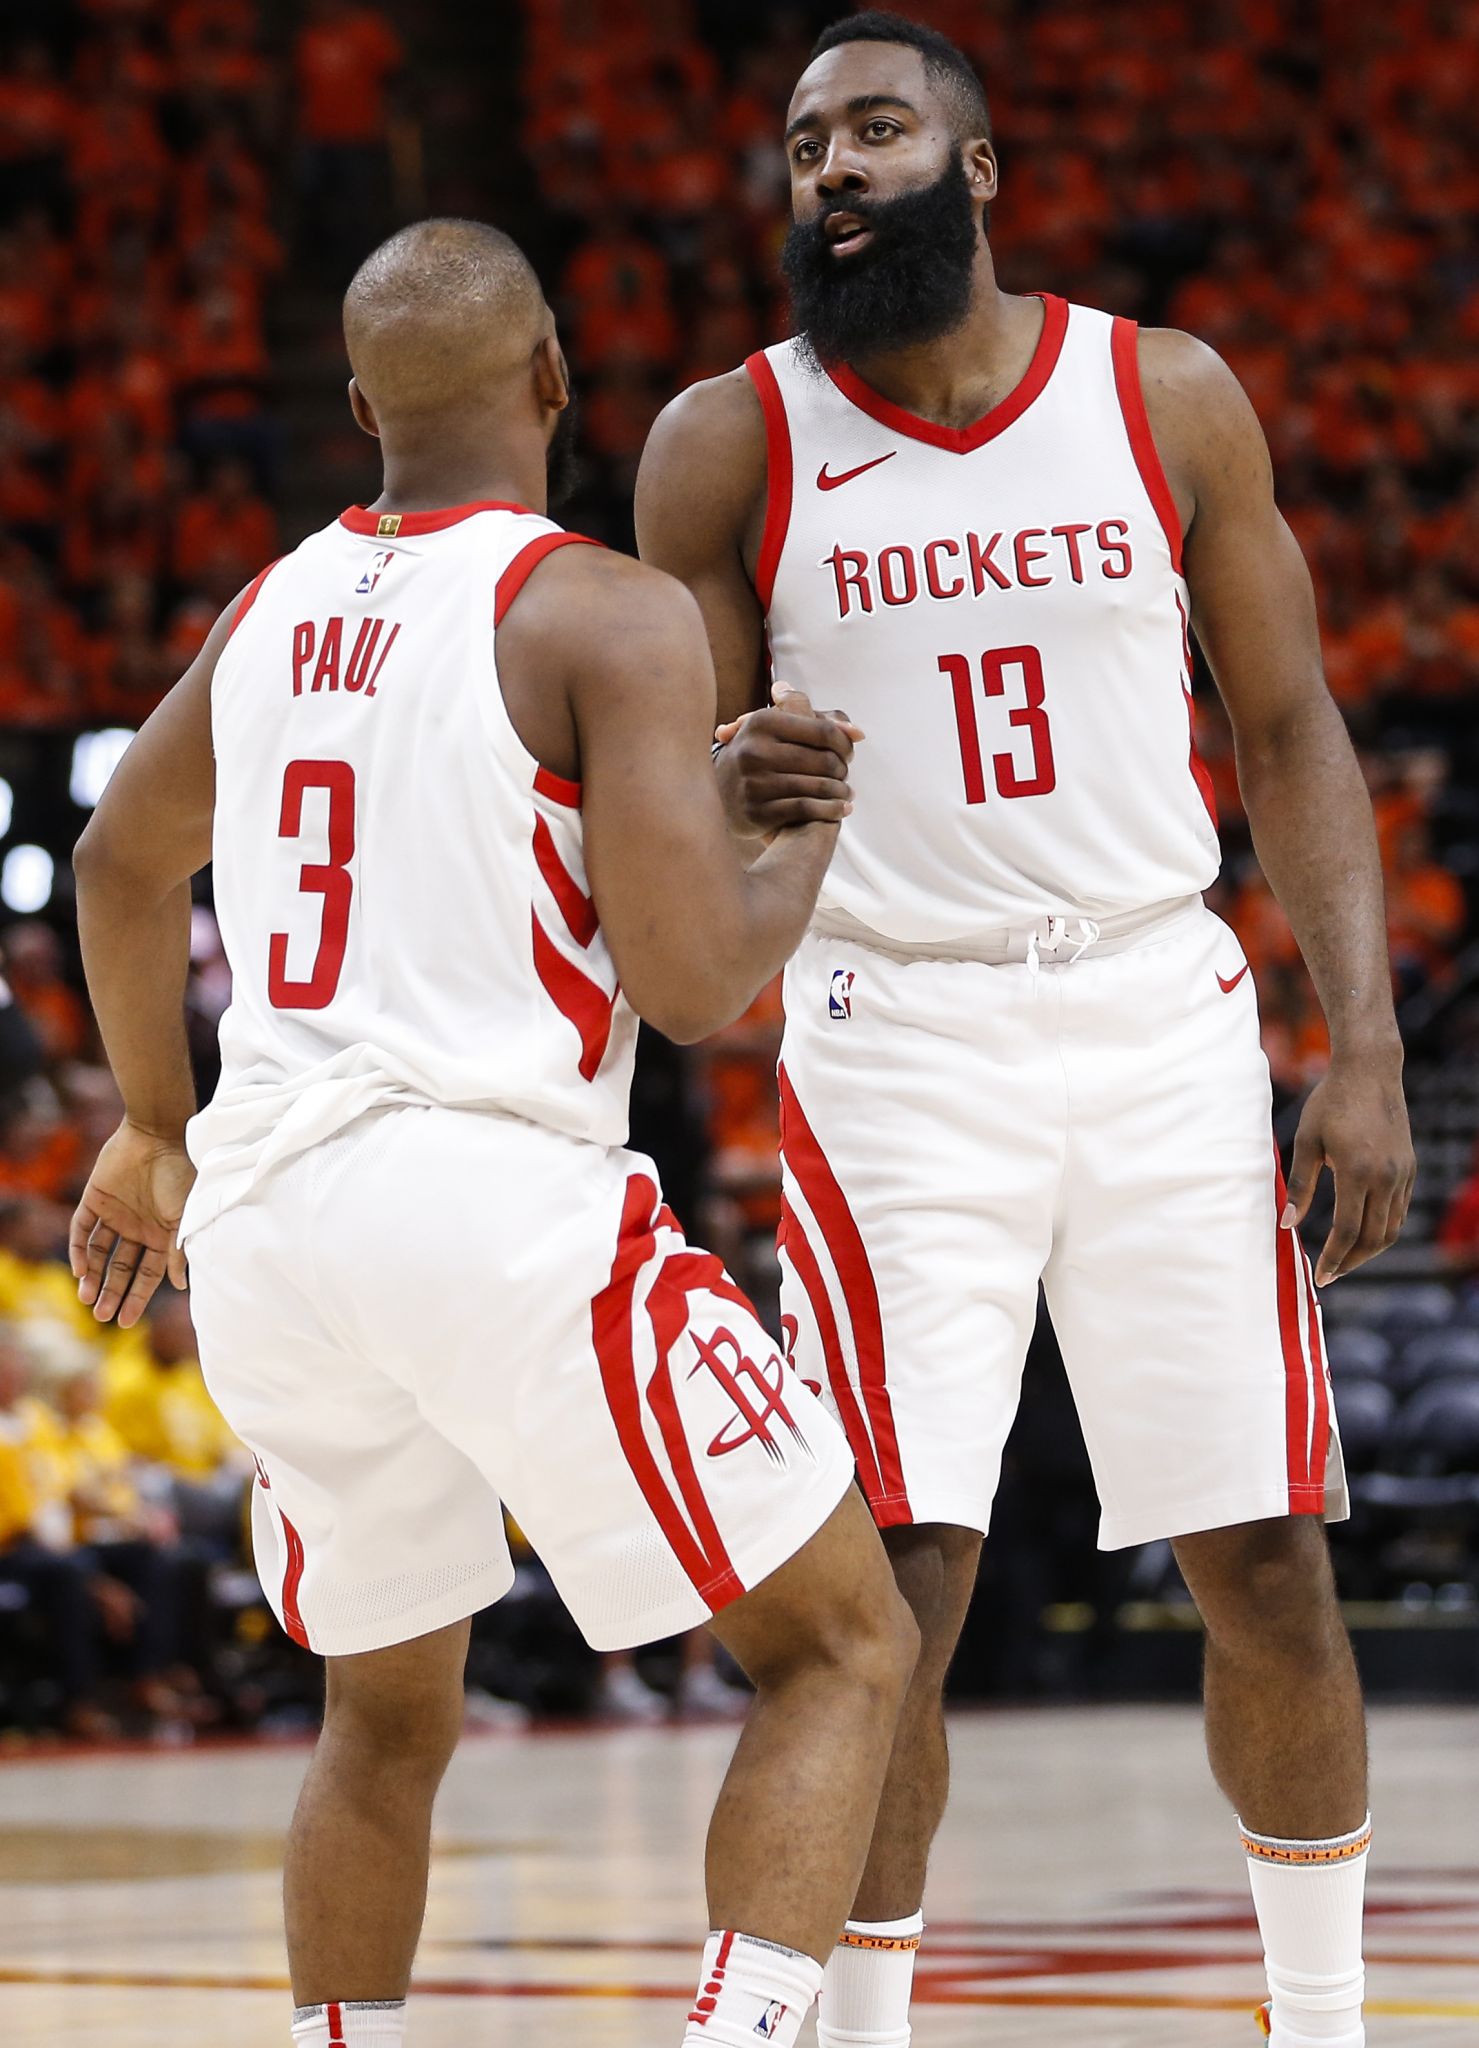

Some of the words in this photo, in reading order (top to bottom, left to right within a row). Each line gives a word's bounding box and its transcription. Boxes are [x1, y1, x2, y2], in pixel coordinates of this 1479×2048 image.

[821, 519, 1132, 618] ROCKETS
[293, 616, 402, 697] PAUL
[937, 645, 1056, 805] 13
[268, 759, 356, 1010] 3
